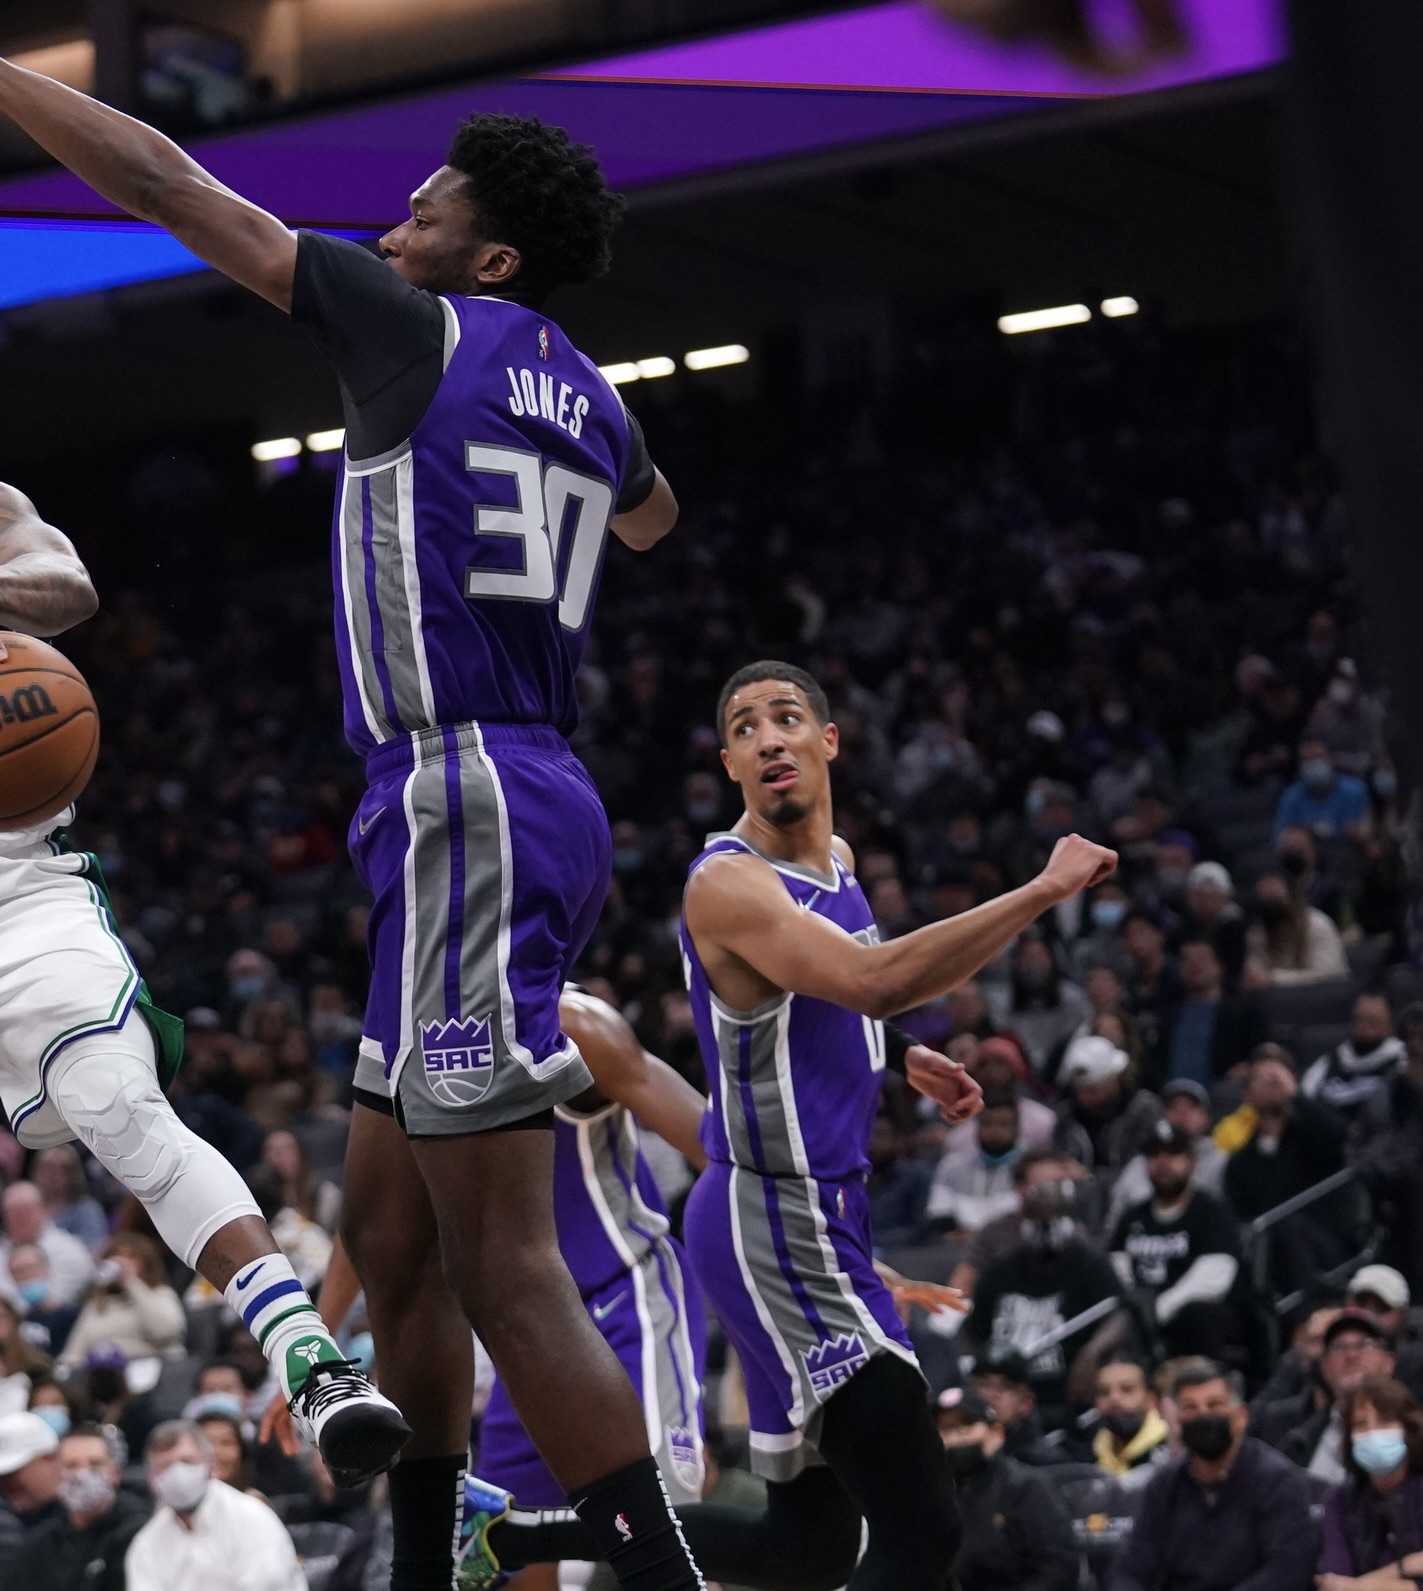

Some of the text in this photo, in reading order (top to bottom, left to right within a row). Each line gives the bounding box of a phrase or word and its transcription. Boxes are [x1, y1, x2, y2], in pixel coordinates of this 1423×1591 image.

[506, 366, 590, 439] JONES
[464, 440, 617, 633] 30
[424, 1047, 492, 1072] SAC
